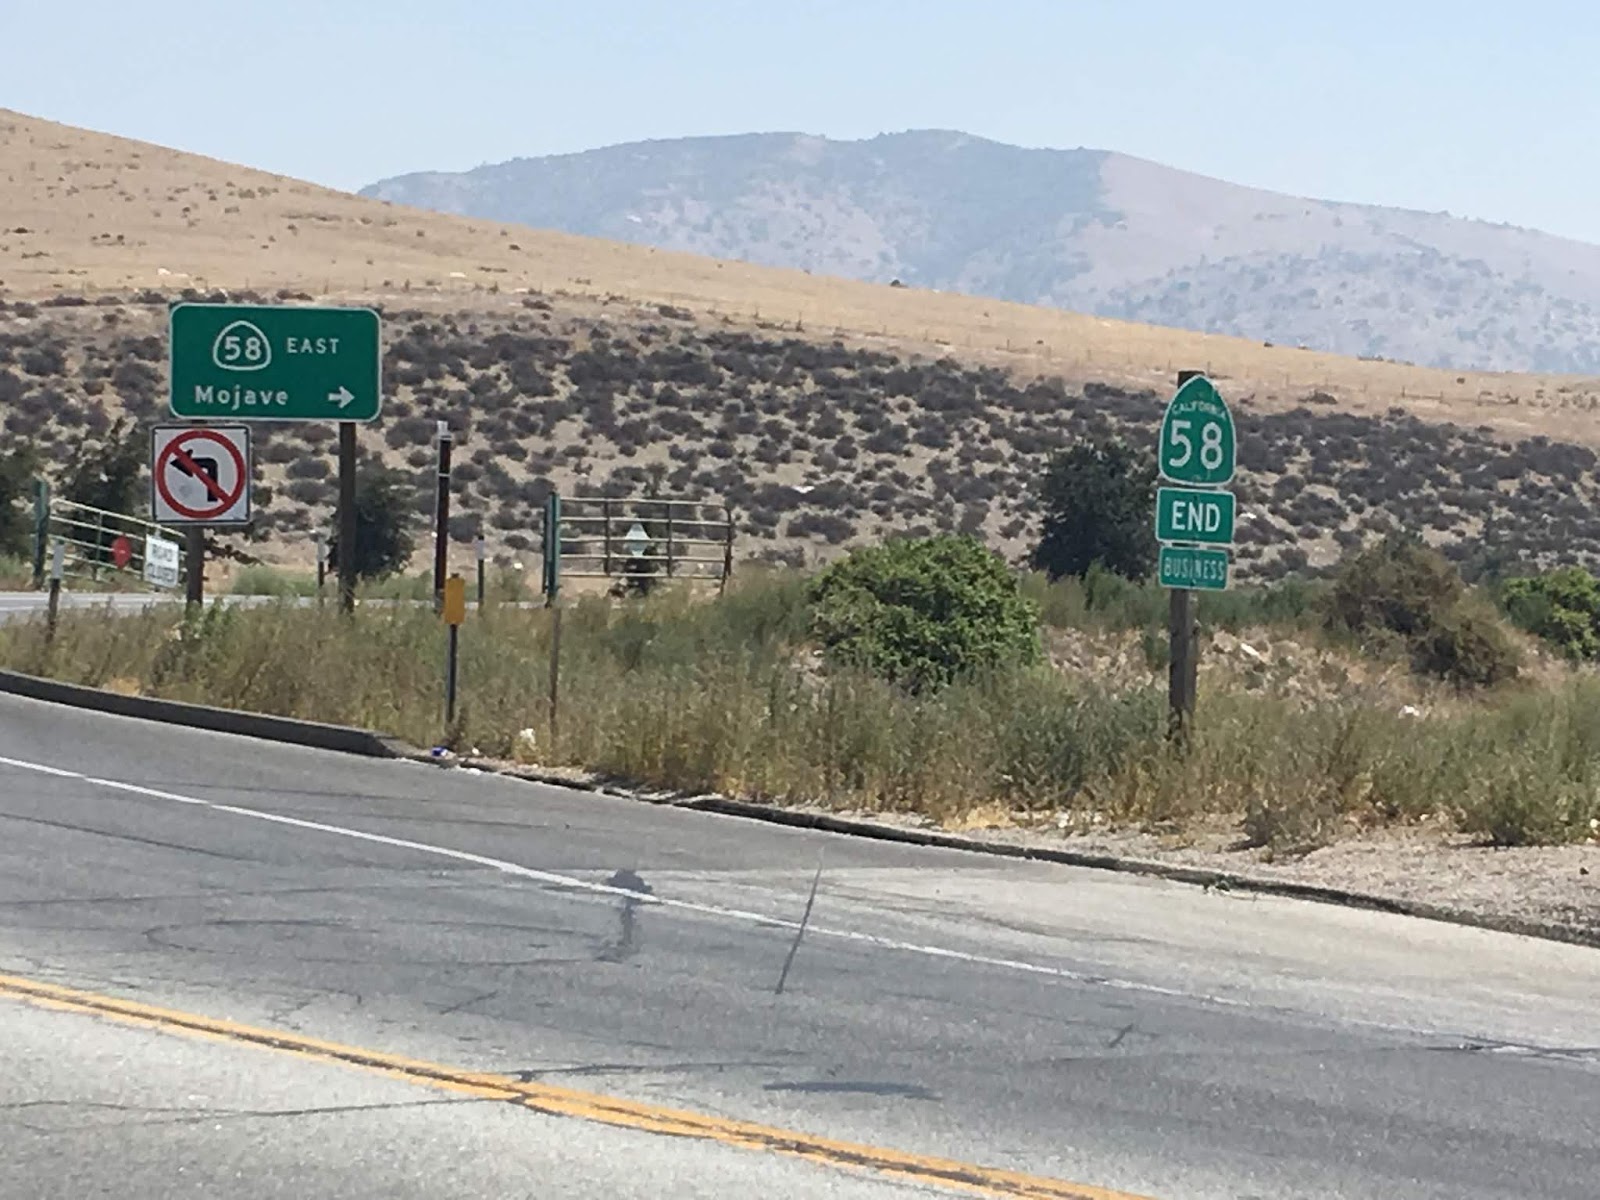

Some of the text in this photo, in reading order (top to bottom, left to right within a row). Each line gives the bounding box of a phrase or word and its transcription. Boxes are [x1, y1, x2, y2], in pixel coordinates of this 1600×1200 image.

[224, 335, 340, 361] 58 EAST
[194, 384, 289, 411] Mojave
[1168, 419, 1224, 470] 58
[1171, 500, 1221, 532] END
[1163, 556, 1225, 581] BUSINESS
